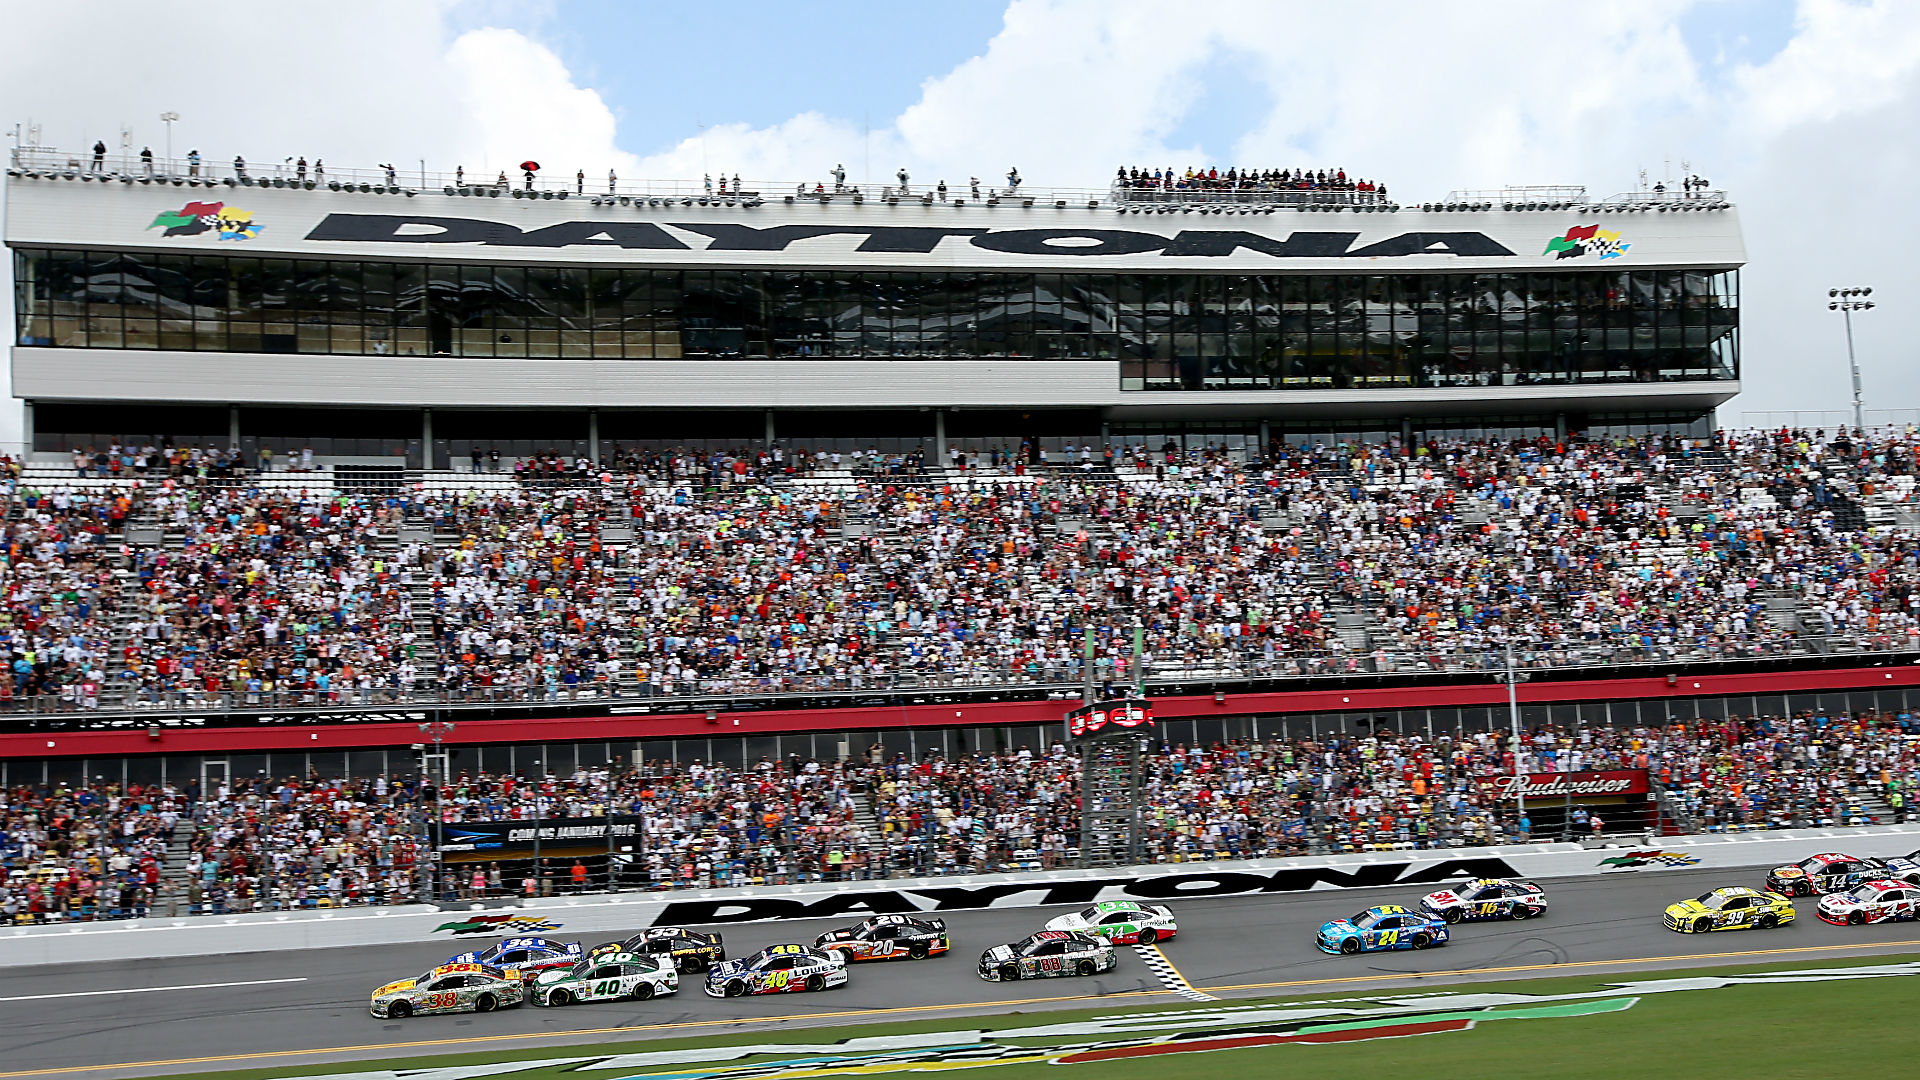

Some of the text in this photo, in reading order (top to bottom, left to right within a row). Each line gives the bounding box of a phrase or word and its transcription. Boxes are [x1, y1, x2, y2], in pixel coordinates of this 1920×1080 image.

[303, 213, 1518, 258] DAYTONA
[1494, 775, 1632, 800] Budweiser
[508, 827, 556, 841] COMNG
[557, 825, 607, 840] JANUARY
[1858, 869, 1882, 879] DUCKS
[1828, 874, 1847, 889] 14
[650, 857, 1524, 927] DAYTONA
[1430, 891, 1459, 905] 3M
[1525, 896, 1536, 904] 3M
[1380, 905, 1404, 915] 24
[1479, 902, 1498, 915] 16
[1883, 902, 1903, 917] 4
[875, 915, 905, 925] 20
[1726, 911, 1745, 925] 99
[647, 927, 681, 939] 33
[1105, 926, 1125, 939] 34
[1378, 930, 1398, 945] 24
[506, 938, 533, 949] 36
[772, 944, 801, 954] 48
[871, 939, 894, 956] 20
[597, 952, 633, 963] 40
[1040, 958, 1062, 972] 88
[765, 971, 789, 987] 48
[593, 980, 621, 996] 40
[427, 992, 457, 1009] 38
